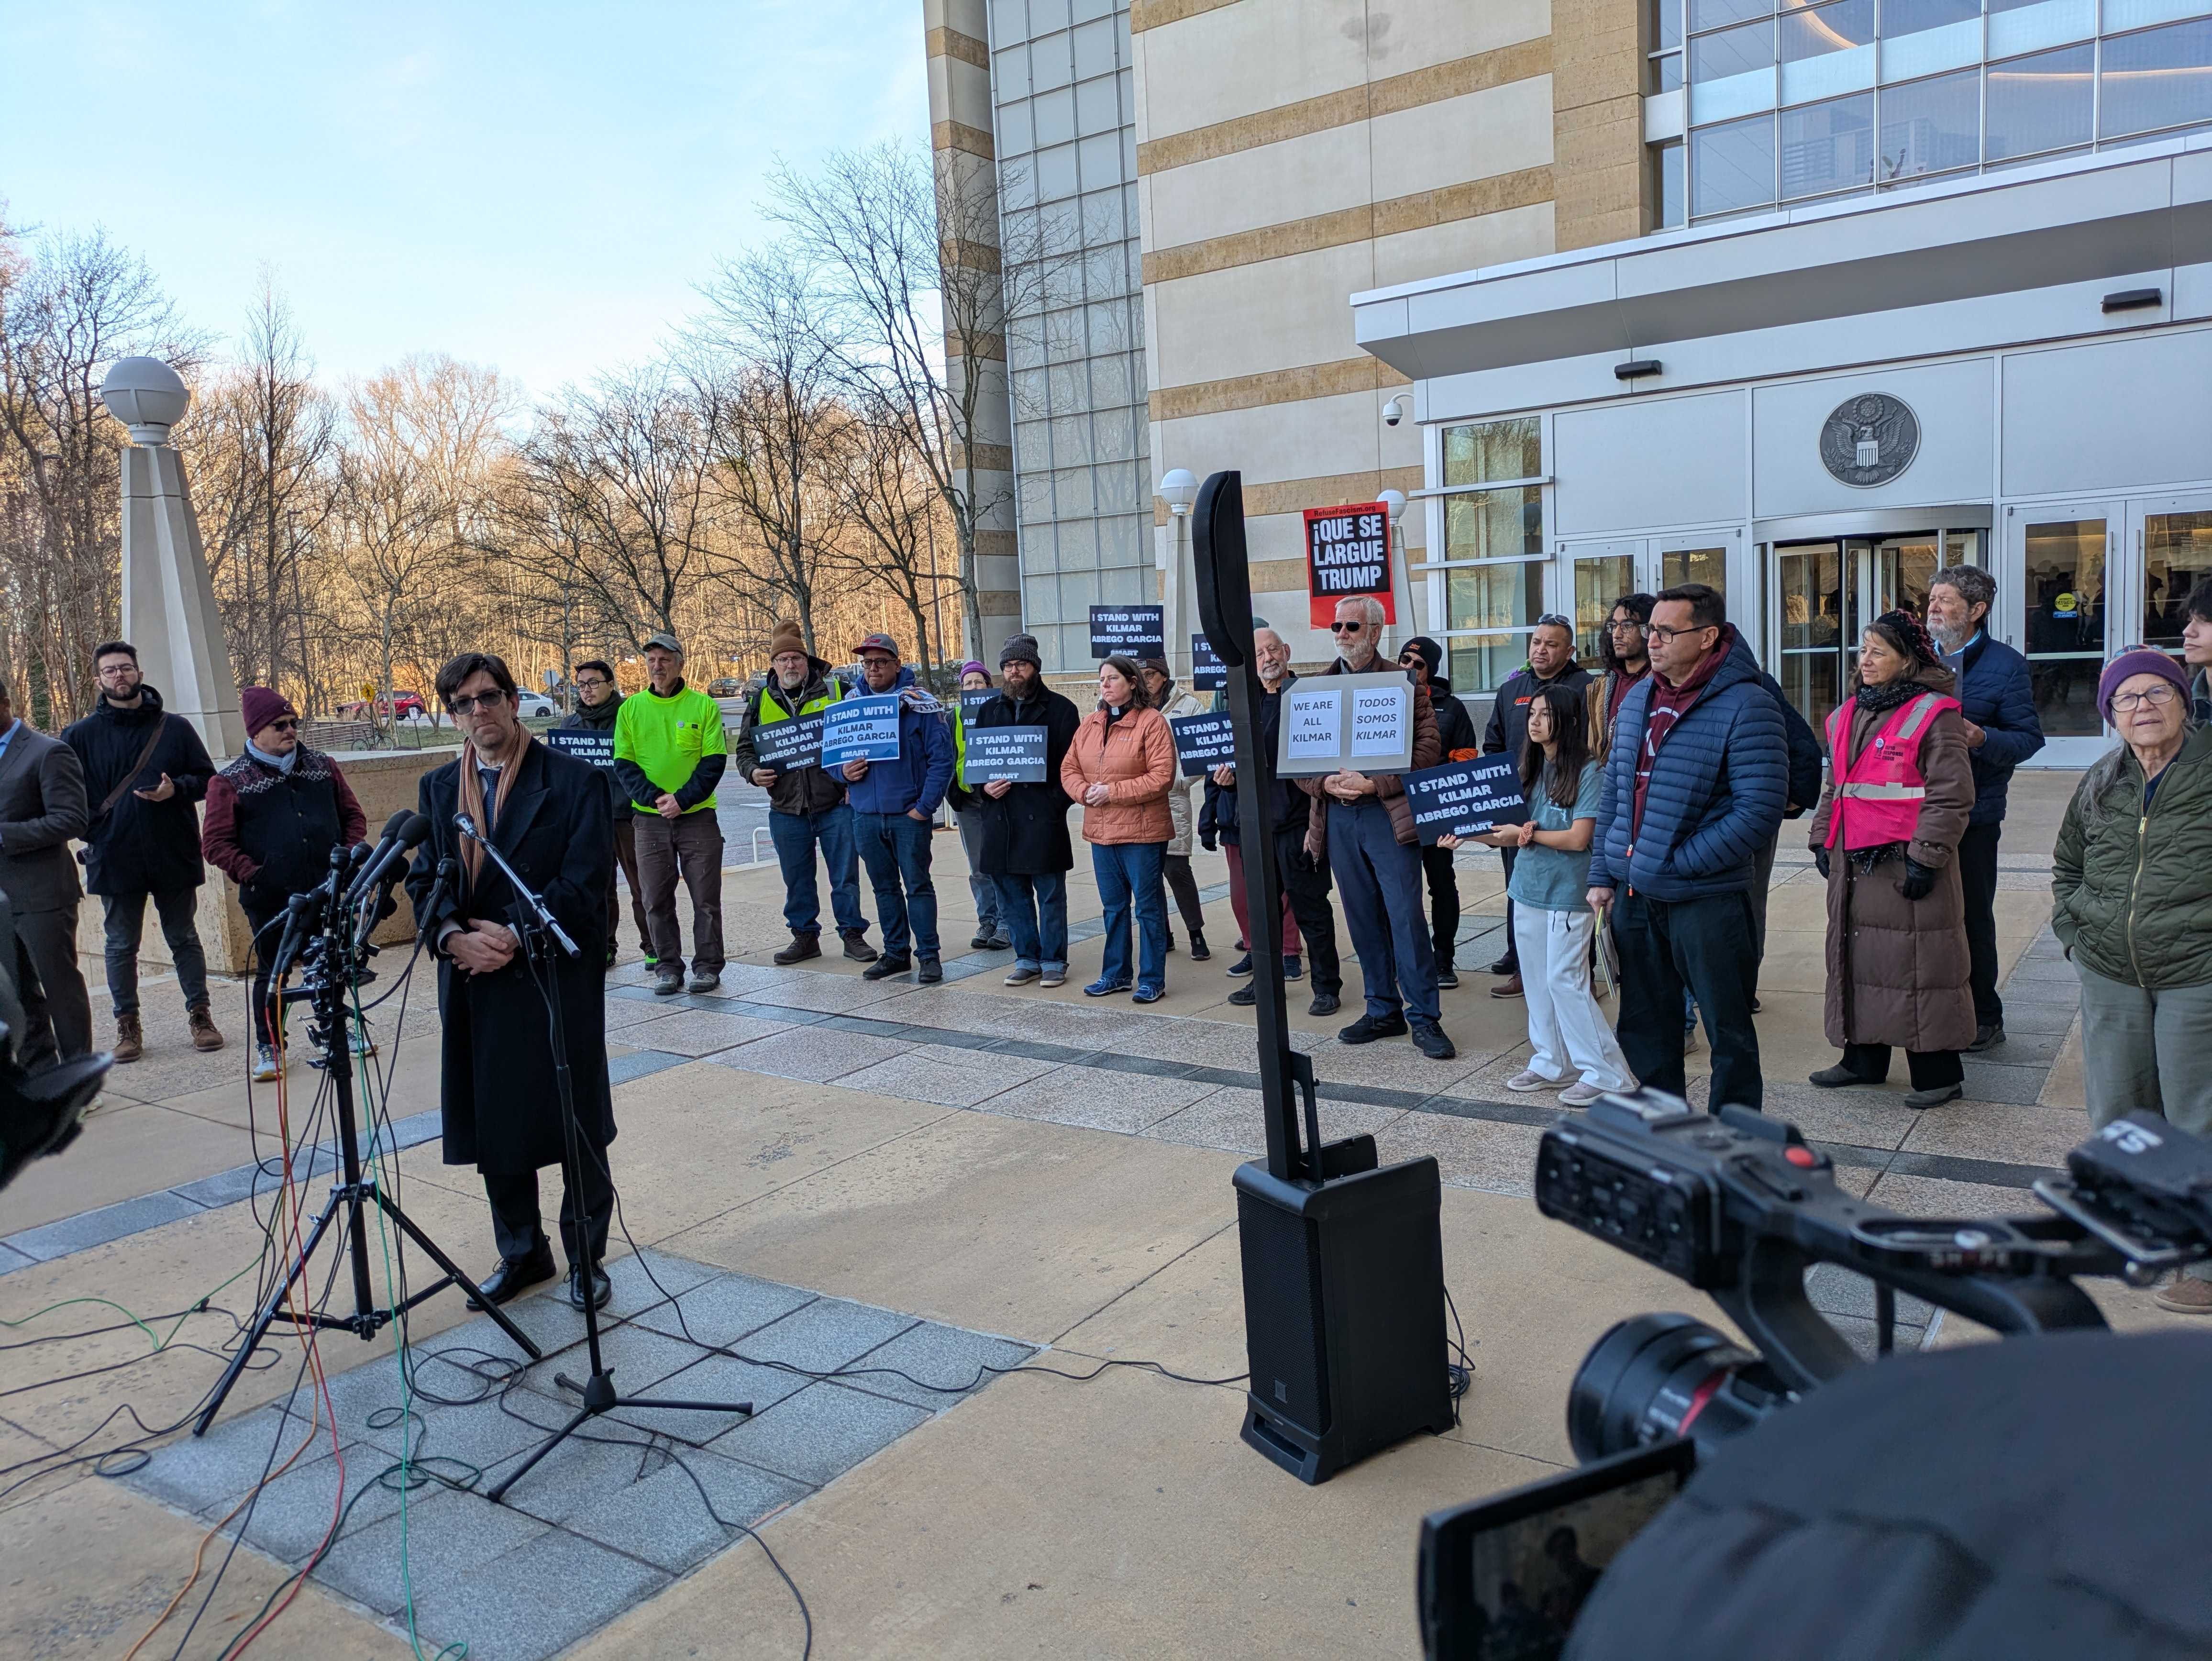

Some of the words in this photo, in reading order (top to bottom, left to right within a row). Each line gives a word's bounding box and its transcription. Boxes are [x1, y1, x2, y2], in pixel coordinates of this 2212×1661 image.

[1314, 506, 1376, 517] RefuseFascism.org
[1314, 518, 1354, 544] ¡QUE
[1359, 515, 1382, 537] SE
[1314, 540, 1384, 566] LARGUE
[1318, 565, 1382, 590] TRUMP
[1097, 613, 1128, 621] STAND
[1132, 613, 1159, 621] WITH
[1195, 642, 1198, 651] I
[1194, 665, 1227, 674] ABREGO
[970, 696, 995, 705] STA
[1294, 702, 1310, 711] WE
[1313, 701, 1333, 710] ARE
[1359, 698, 1396, 708] TODOS
[827, 715, 830, 724] I
[831, 709, 860, 722] STAND
[863, 705, 893, 716] WITH
[1357, 714, 1397, 724] SOMOS
[1303, 717, 1322, 726] ALL
[762, 725, 797, 740] STAND
[838, 722, 873, 735] KILMAR
[1175, 727, 1180, 736] I
[1183, 722, 1219, 735] STAND
[775, 732, 814, 748] KILMAR
[824, 735, 853, 748] ABREGO
[857, 731, 896, 742] GARCIA
[976, 735, 1010, 745] STAND
[1014, 734, 1042, 742] WITH
[1293, 732, 1332, 742] KILMAR
[1356, 730, 1396, 740] KILMAR
[559, 737, 595, 745] STAND
[571, 748, 610, 756] KILMAR
[760, 747, 797, 763] ABREGO
[799, 740, 823, 752] GARC
[841, 749, 870, 758] SMART
[985, 746, 1024, 755] KILMAR
[1181, 748, 1218, 759] ABREGO
[786, 757, 815, 769] SMART
[965, 758, 1004, 767] ABREGO
[1409, 784, 1416, 795] I
[1419, 773, 1468, 792] STAND
[1471, 764, 1512, 781] WITH
[1438, 785, 1492, 804] KILMAR
[1416, 805, 1469, 824] ABREGO
[1472, 795, 1524, 812] GARCIA
[1454, 820, 1493, 835] SMART
